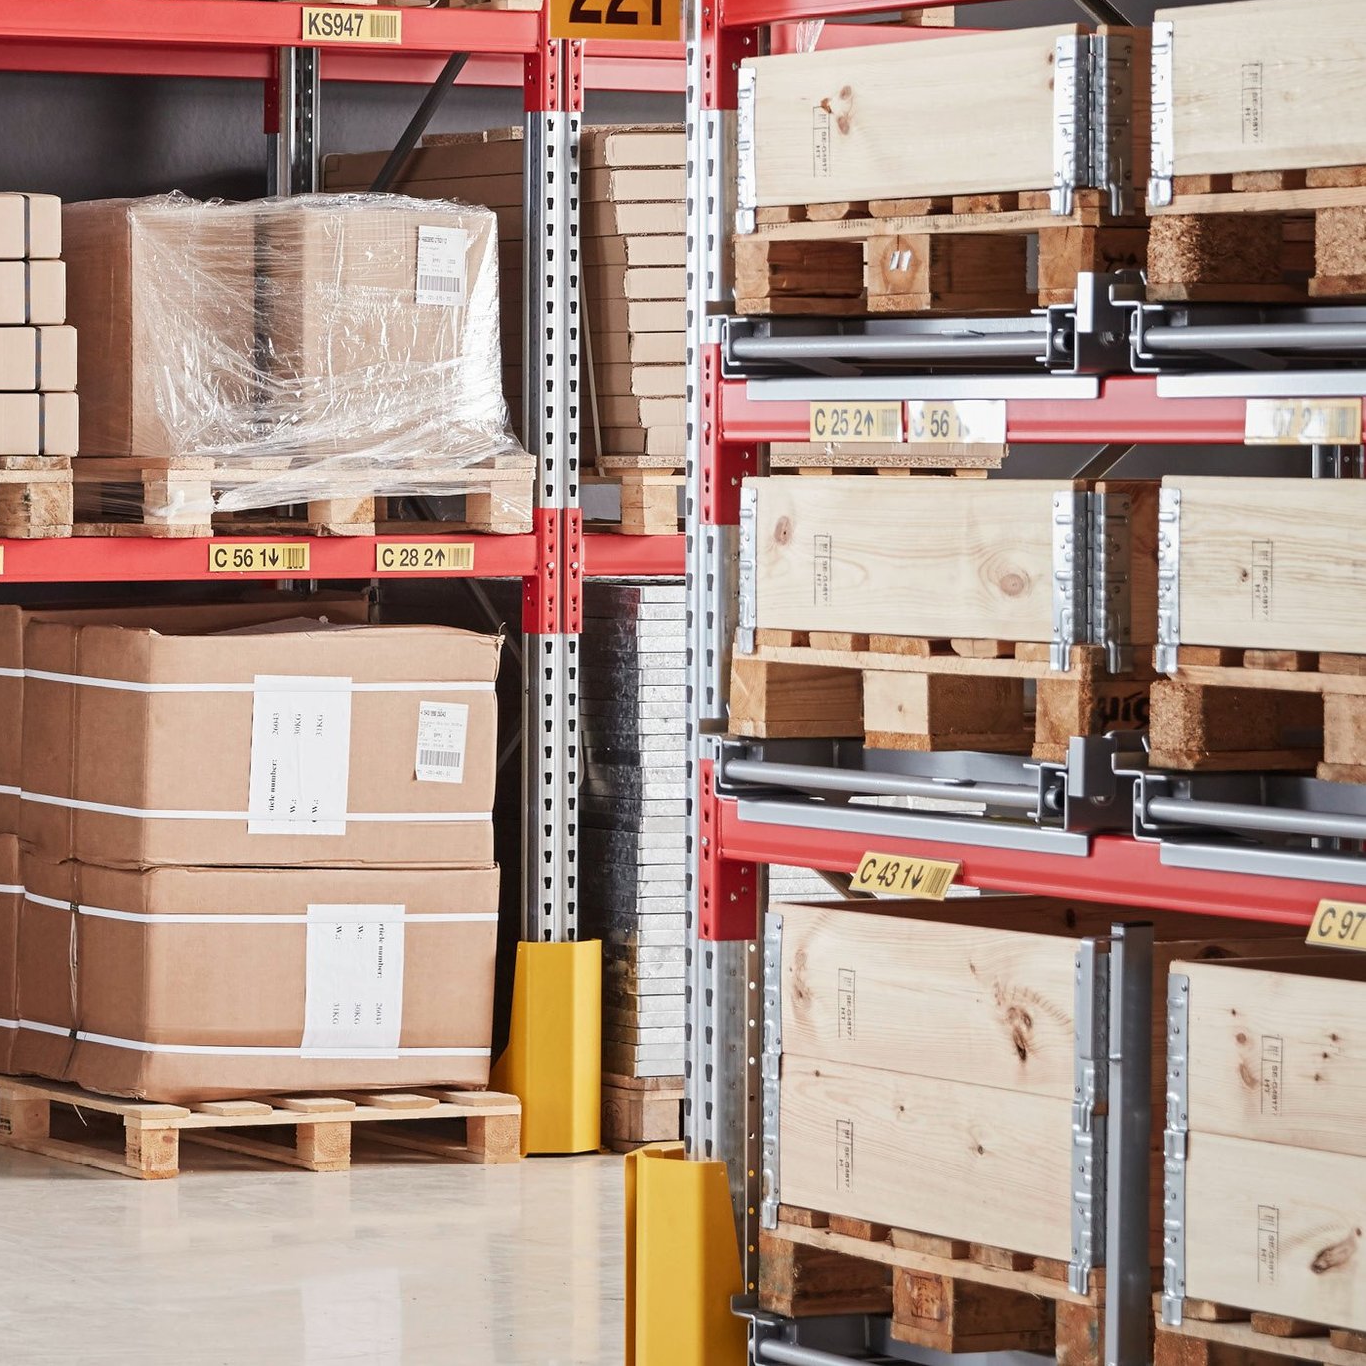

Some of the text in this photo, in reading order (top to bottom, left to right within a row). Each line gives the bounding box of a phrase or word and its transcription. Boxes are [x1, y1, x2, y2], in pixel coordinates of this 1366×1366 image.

[309, 13, 363, 36] KS947
[814, 408, 862, 435] C 25 2
[913, 409, 925, 438] C
[930, 409, 949, 438] 56
[214, 548, 266, 567] C 56 1
[382, 548, 433, 567] C 28 2
[860, 859, 913, 888] C 43 1
[1318, 907, 1366, 940] C 97
